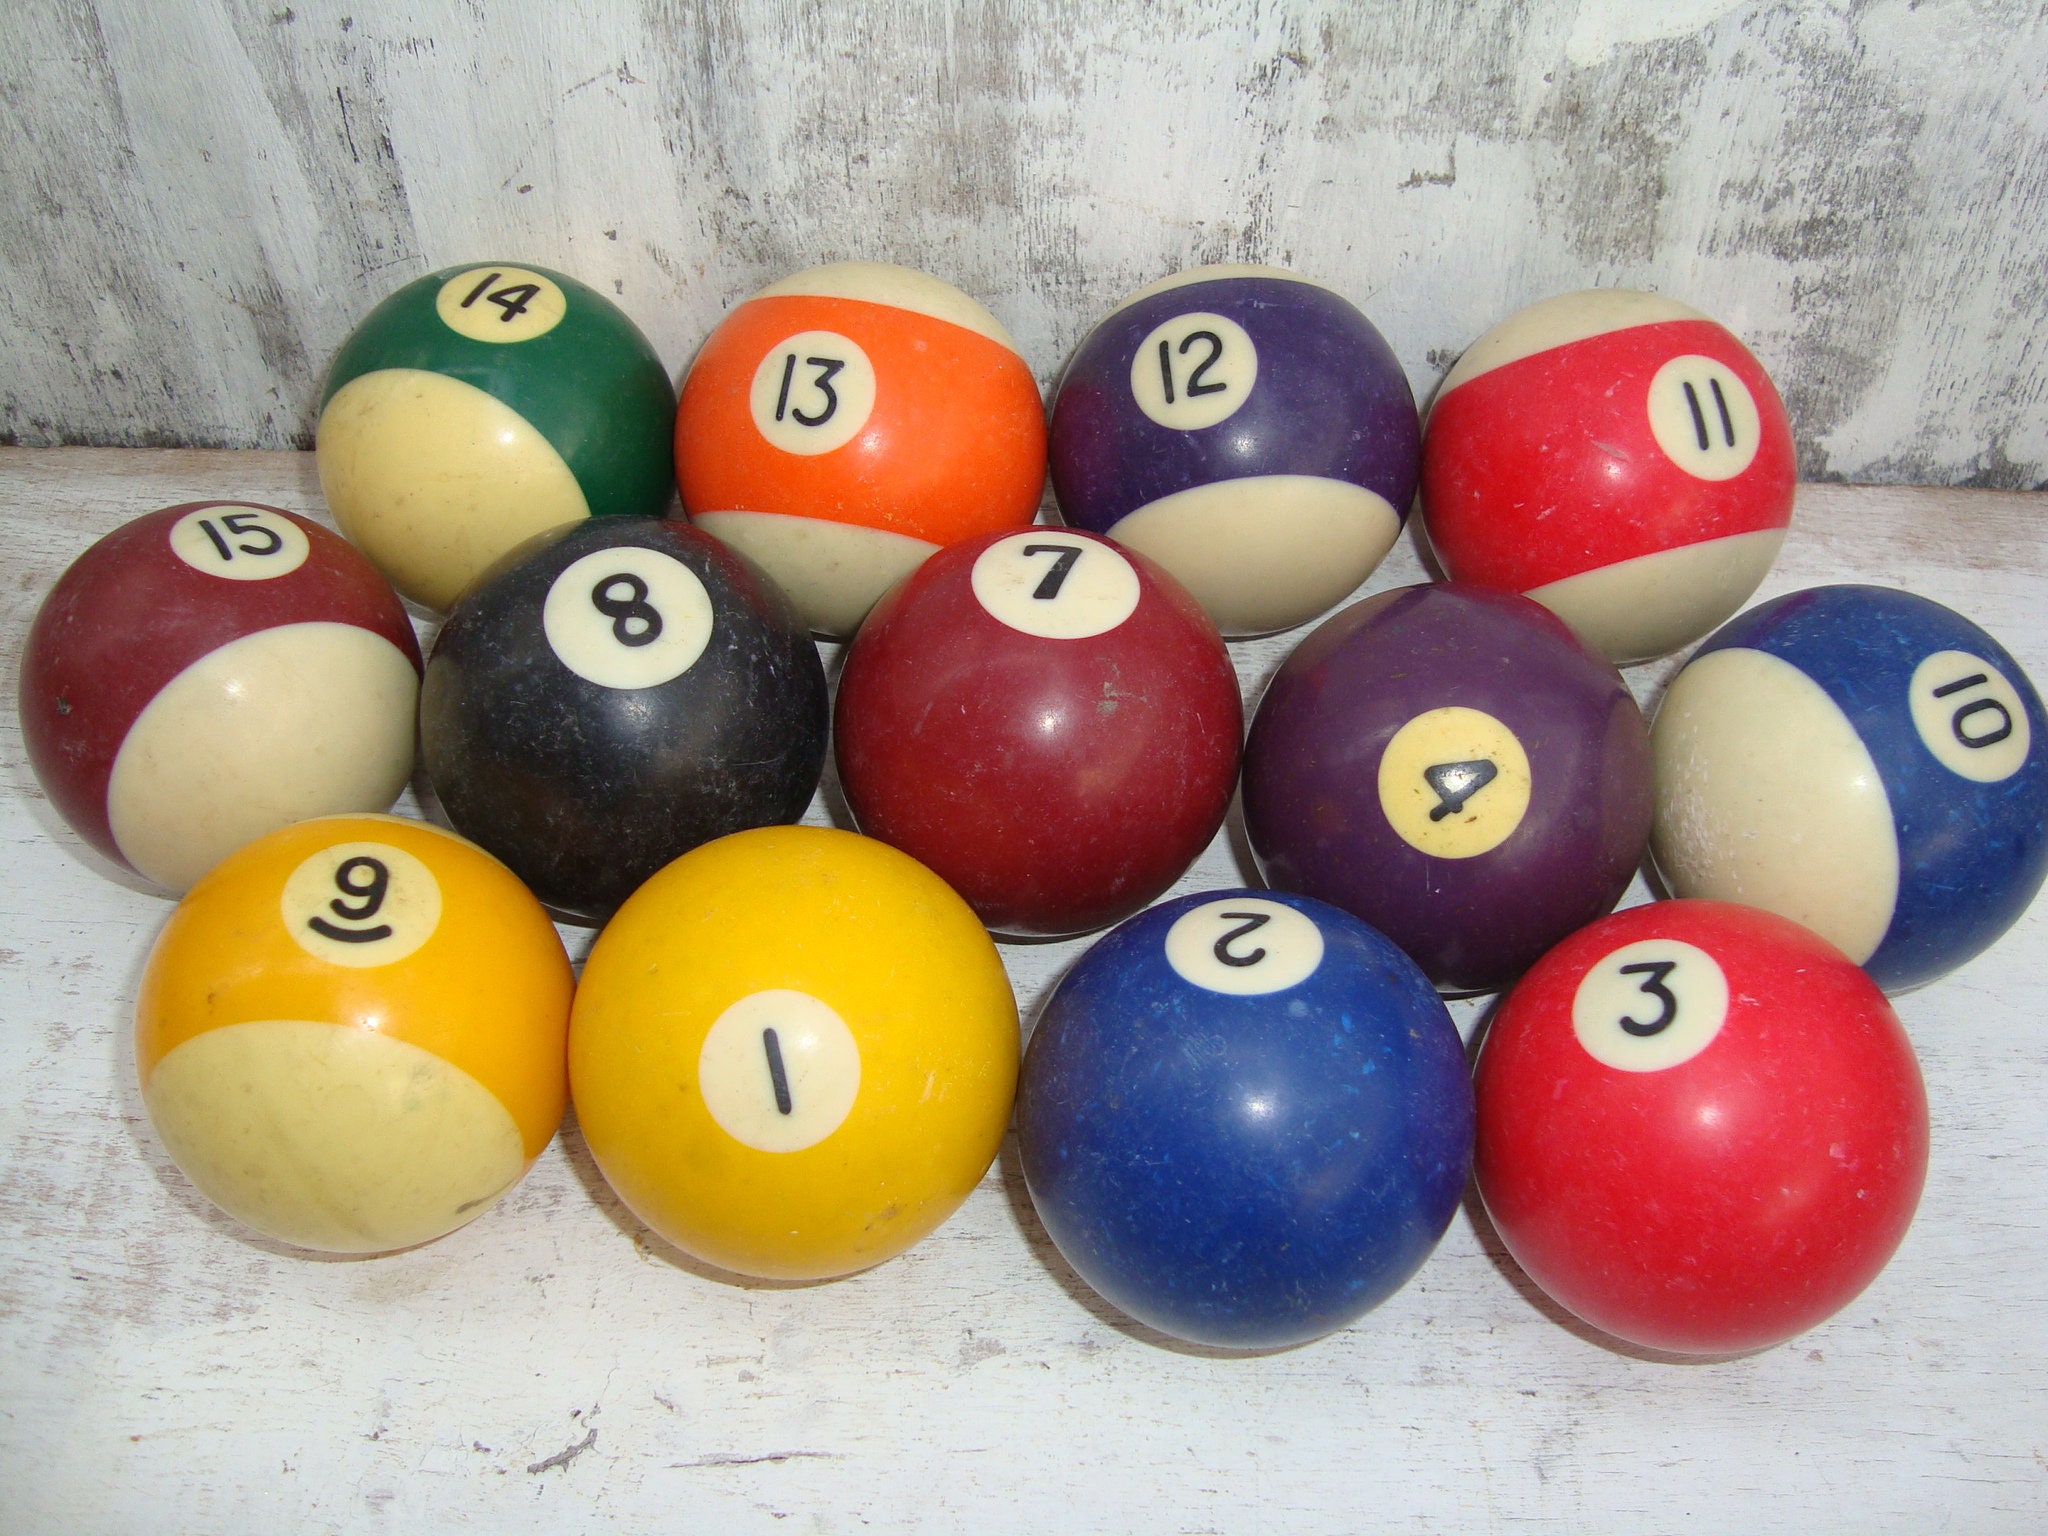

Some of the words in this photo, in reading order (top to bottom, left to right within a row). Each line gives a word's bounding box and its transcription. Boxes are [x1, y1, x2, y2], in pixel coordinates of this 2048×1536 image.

[461, 272, 541, 323] 14
[775, 353, 845, 427] 13
[1158, 330, 1227, 405] 12
[1683, 378, 1735, 451] 11
[197, 513, 283, 561] 15
[1021, 544, 1083, 600] 7
[591, 572, 663, 648] 8
[1932, 673, 2013, 749] 10
[1423, 759, 1498, 823] 4
[312, 856, 391, 941] 9
[1213, 912, 1271, 968] 2
[1619, 961, 1677, 1038] 3
[763, 1028, 792, 1116] 1
